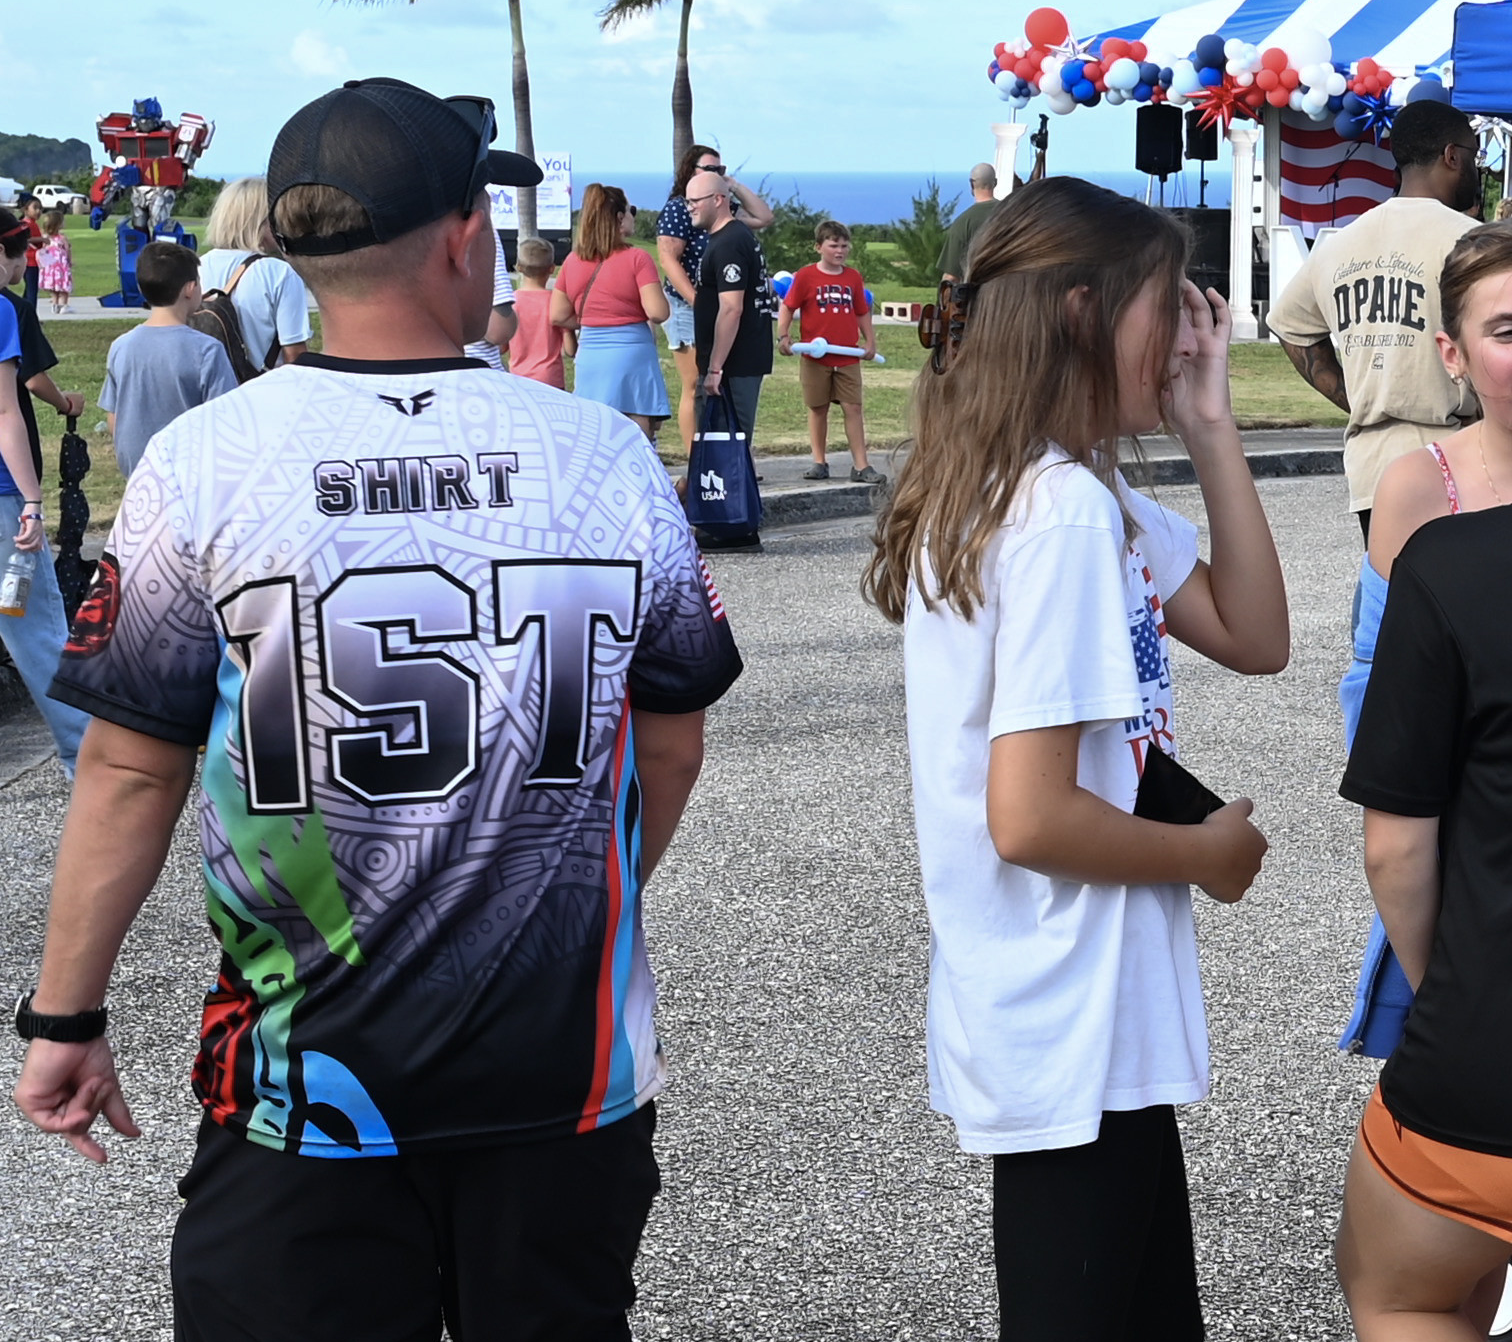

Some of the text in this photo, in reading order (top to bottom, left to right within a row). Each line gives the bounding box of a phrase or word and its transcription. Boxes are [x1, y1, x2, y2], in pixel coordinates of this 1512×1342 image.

[313, 451, 519, 517] SHIRT
[701, 490, 725, 501] USAA
[215, 558, 643, 816] 1ST
